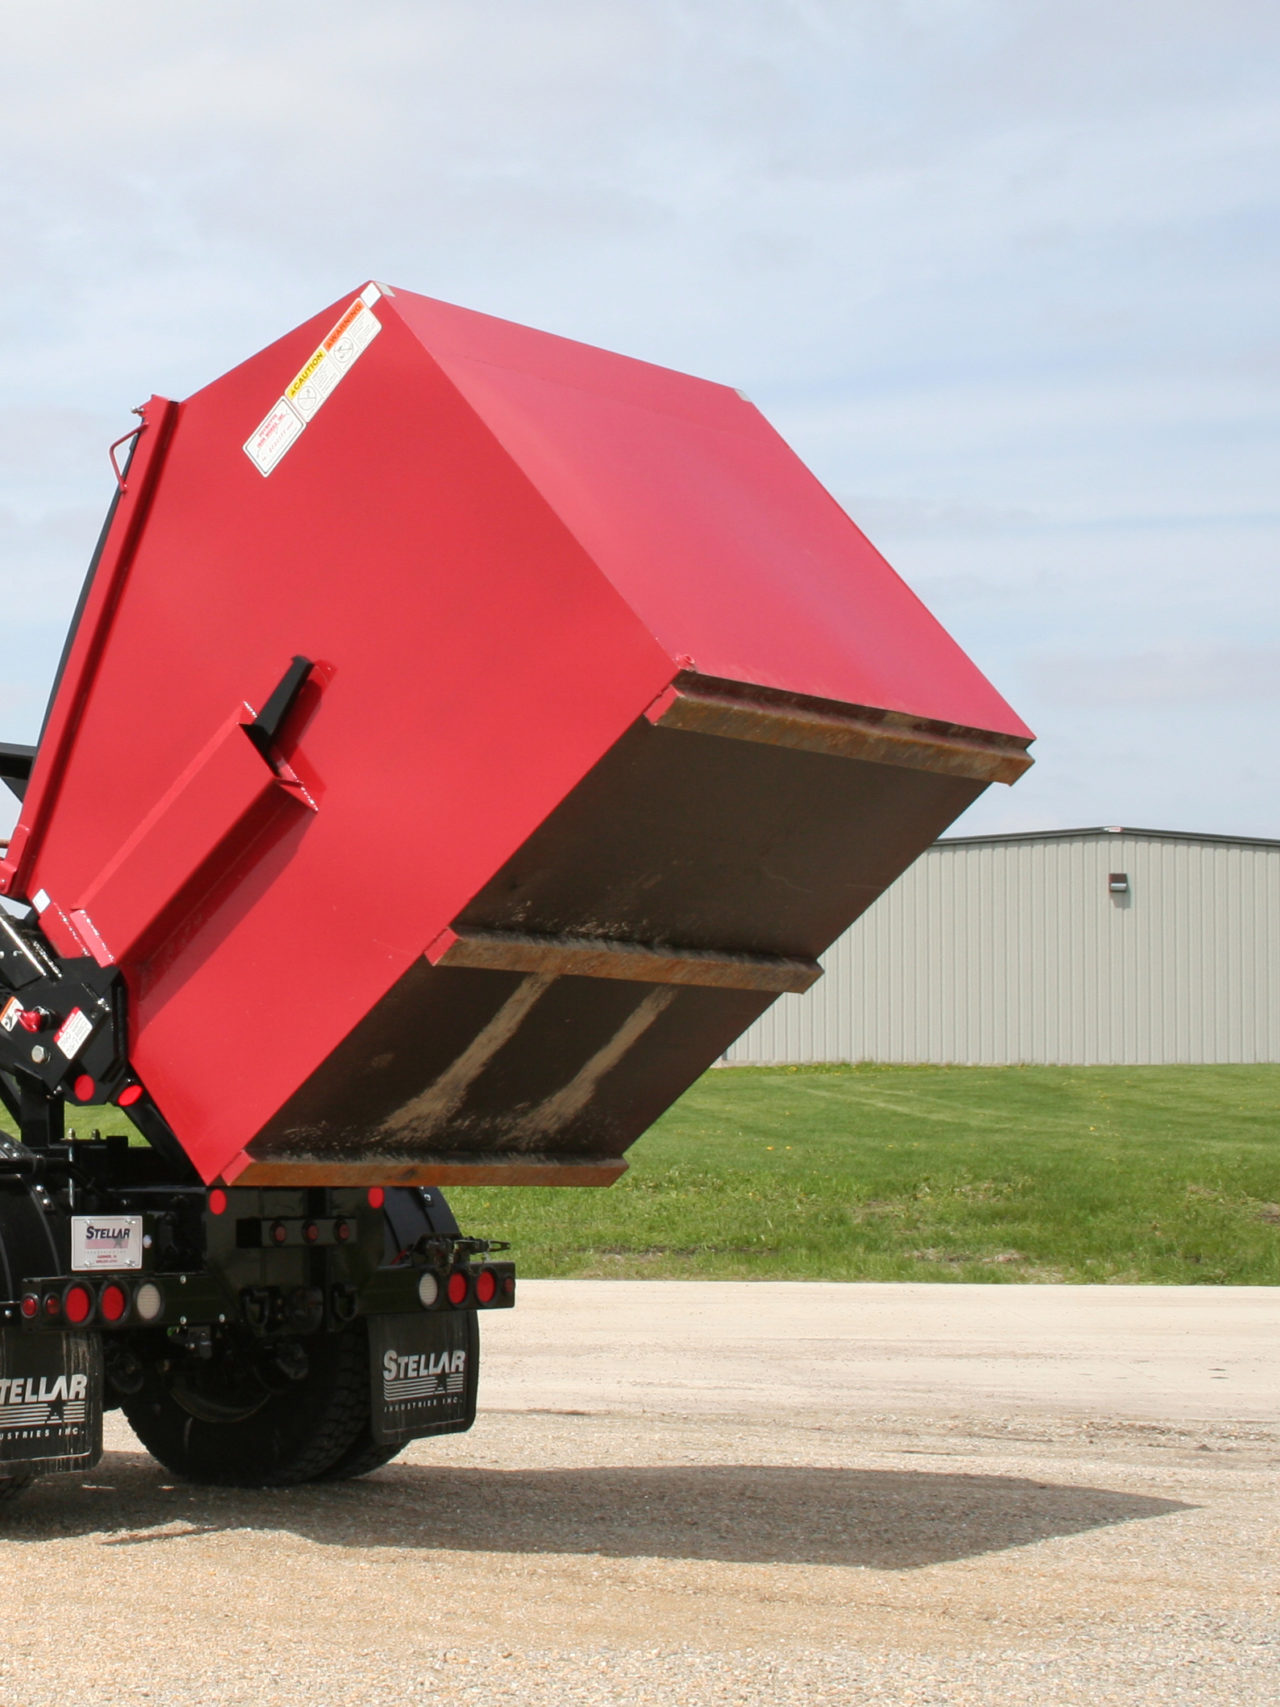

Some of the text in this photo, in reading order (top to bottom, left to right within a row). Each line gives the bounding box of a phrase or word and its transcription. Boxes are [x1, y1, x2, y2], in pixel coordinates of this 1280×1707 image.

[293, 351, 324, 392] CAUTION
[86, 1225, 130, 1239] STELLAR
[383, 1349, 466, 1381] STELLAR
[58, 1427, 85, 1437] INC.
